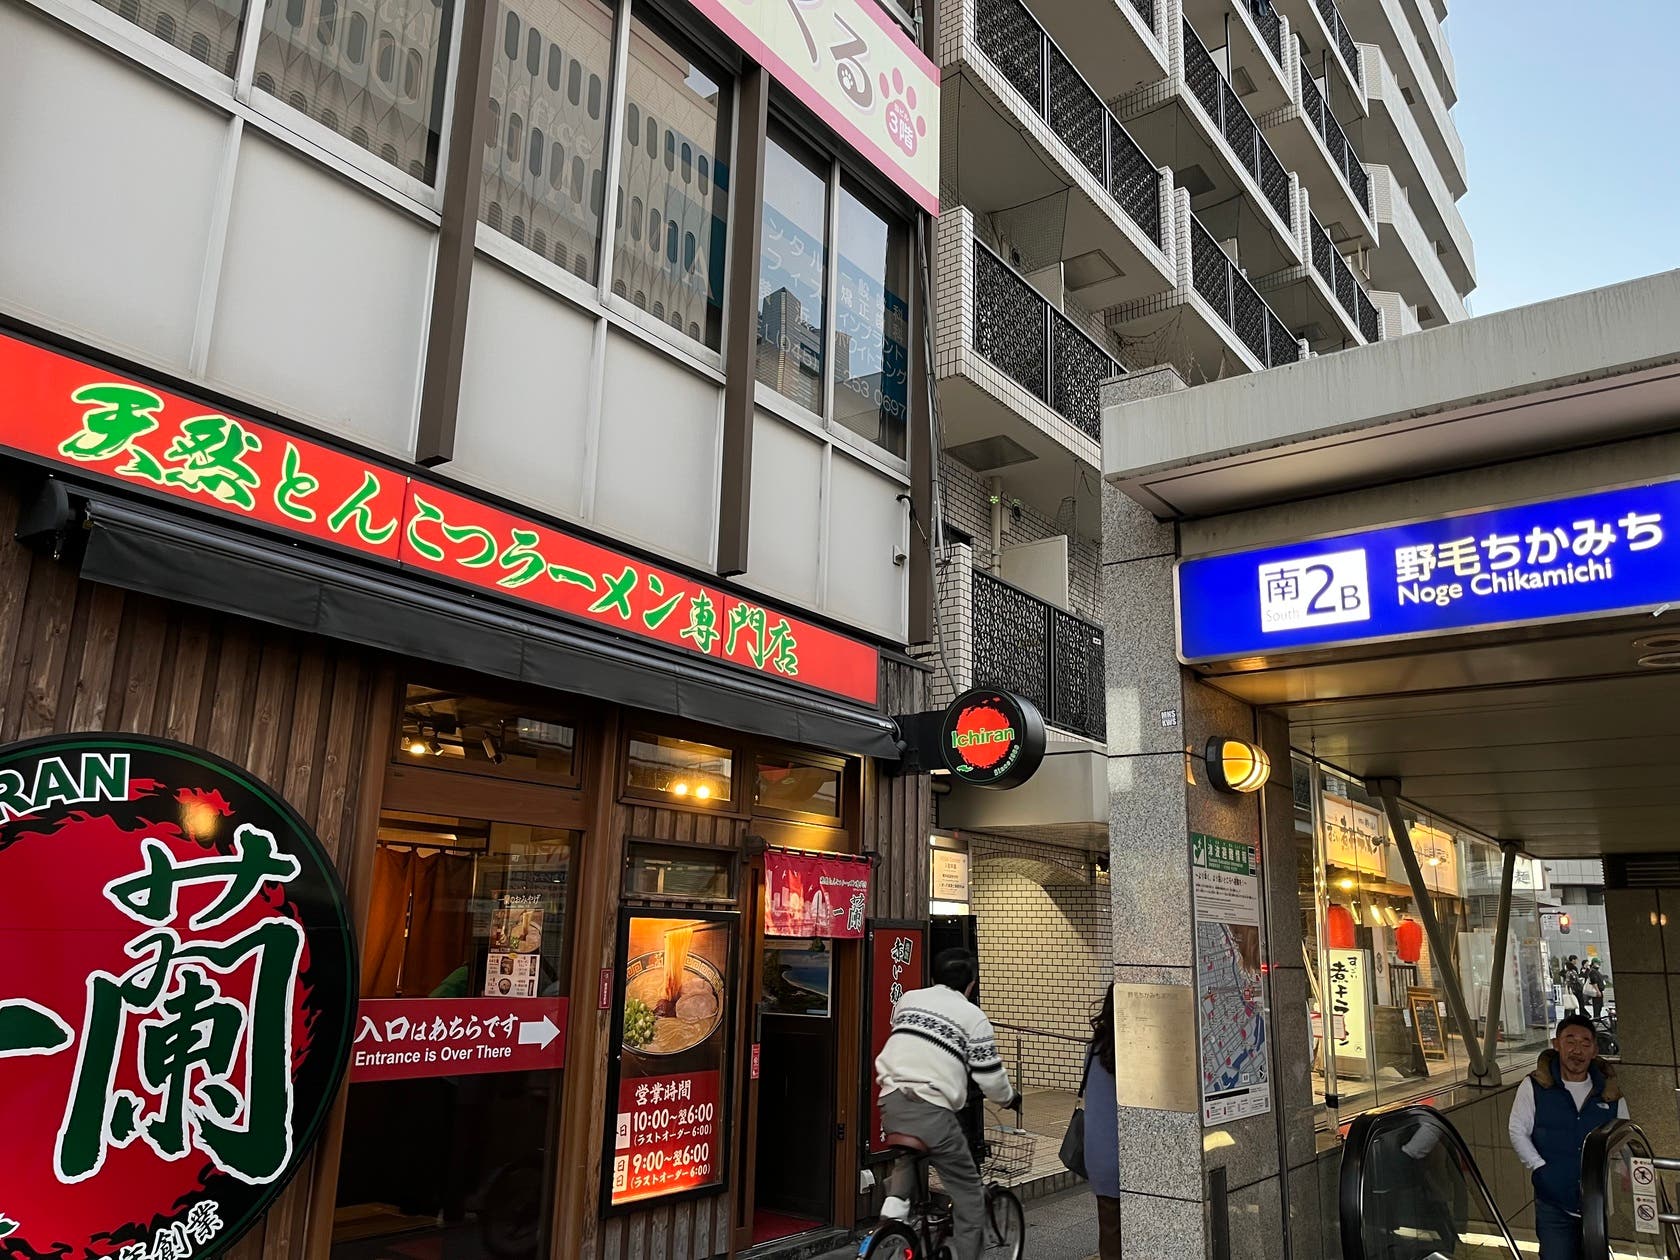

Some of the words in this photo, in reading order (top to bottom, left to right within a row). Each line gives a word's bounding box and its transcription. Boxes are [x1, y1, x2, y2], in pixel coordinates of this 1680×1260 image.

[889, 111, 913, 150] 3階
[873, 388, 907, 420] 0697
[57, 381, 801, 678] 天然とんこつラーメン専門店
[1395, 511, 1664, 583] 野毛ちかみち
[1397, 581, 1463, 607] Noge
[1471, 558, 1613, 597] Chikamichi
[1265, 607, 1301, 623] South
[951, 727, 1015, 749] Ichiran
[1330, 960, 1350, 1046] 煮干ラン
[354, 1013, 518, 1043] 入口はあちらです
[355, 1050, 421, 1067] Entrance
[424, 1048, 437, 1062] is
[440, 1046, 473, 1061] Over
[476, 1044, 512, 1059] There
[635, 1079, 691, 1106] 営業時間
